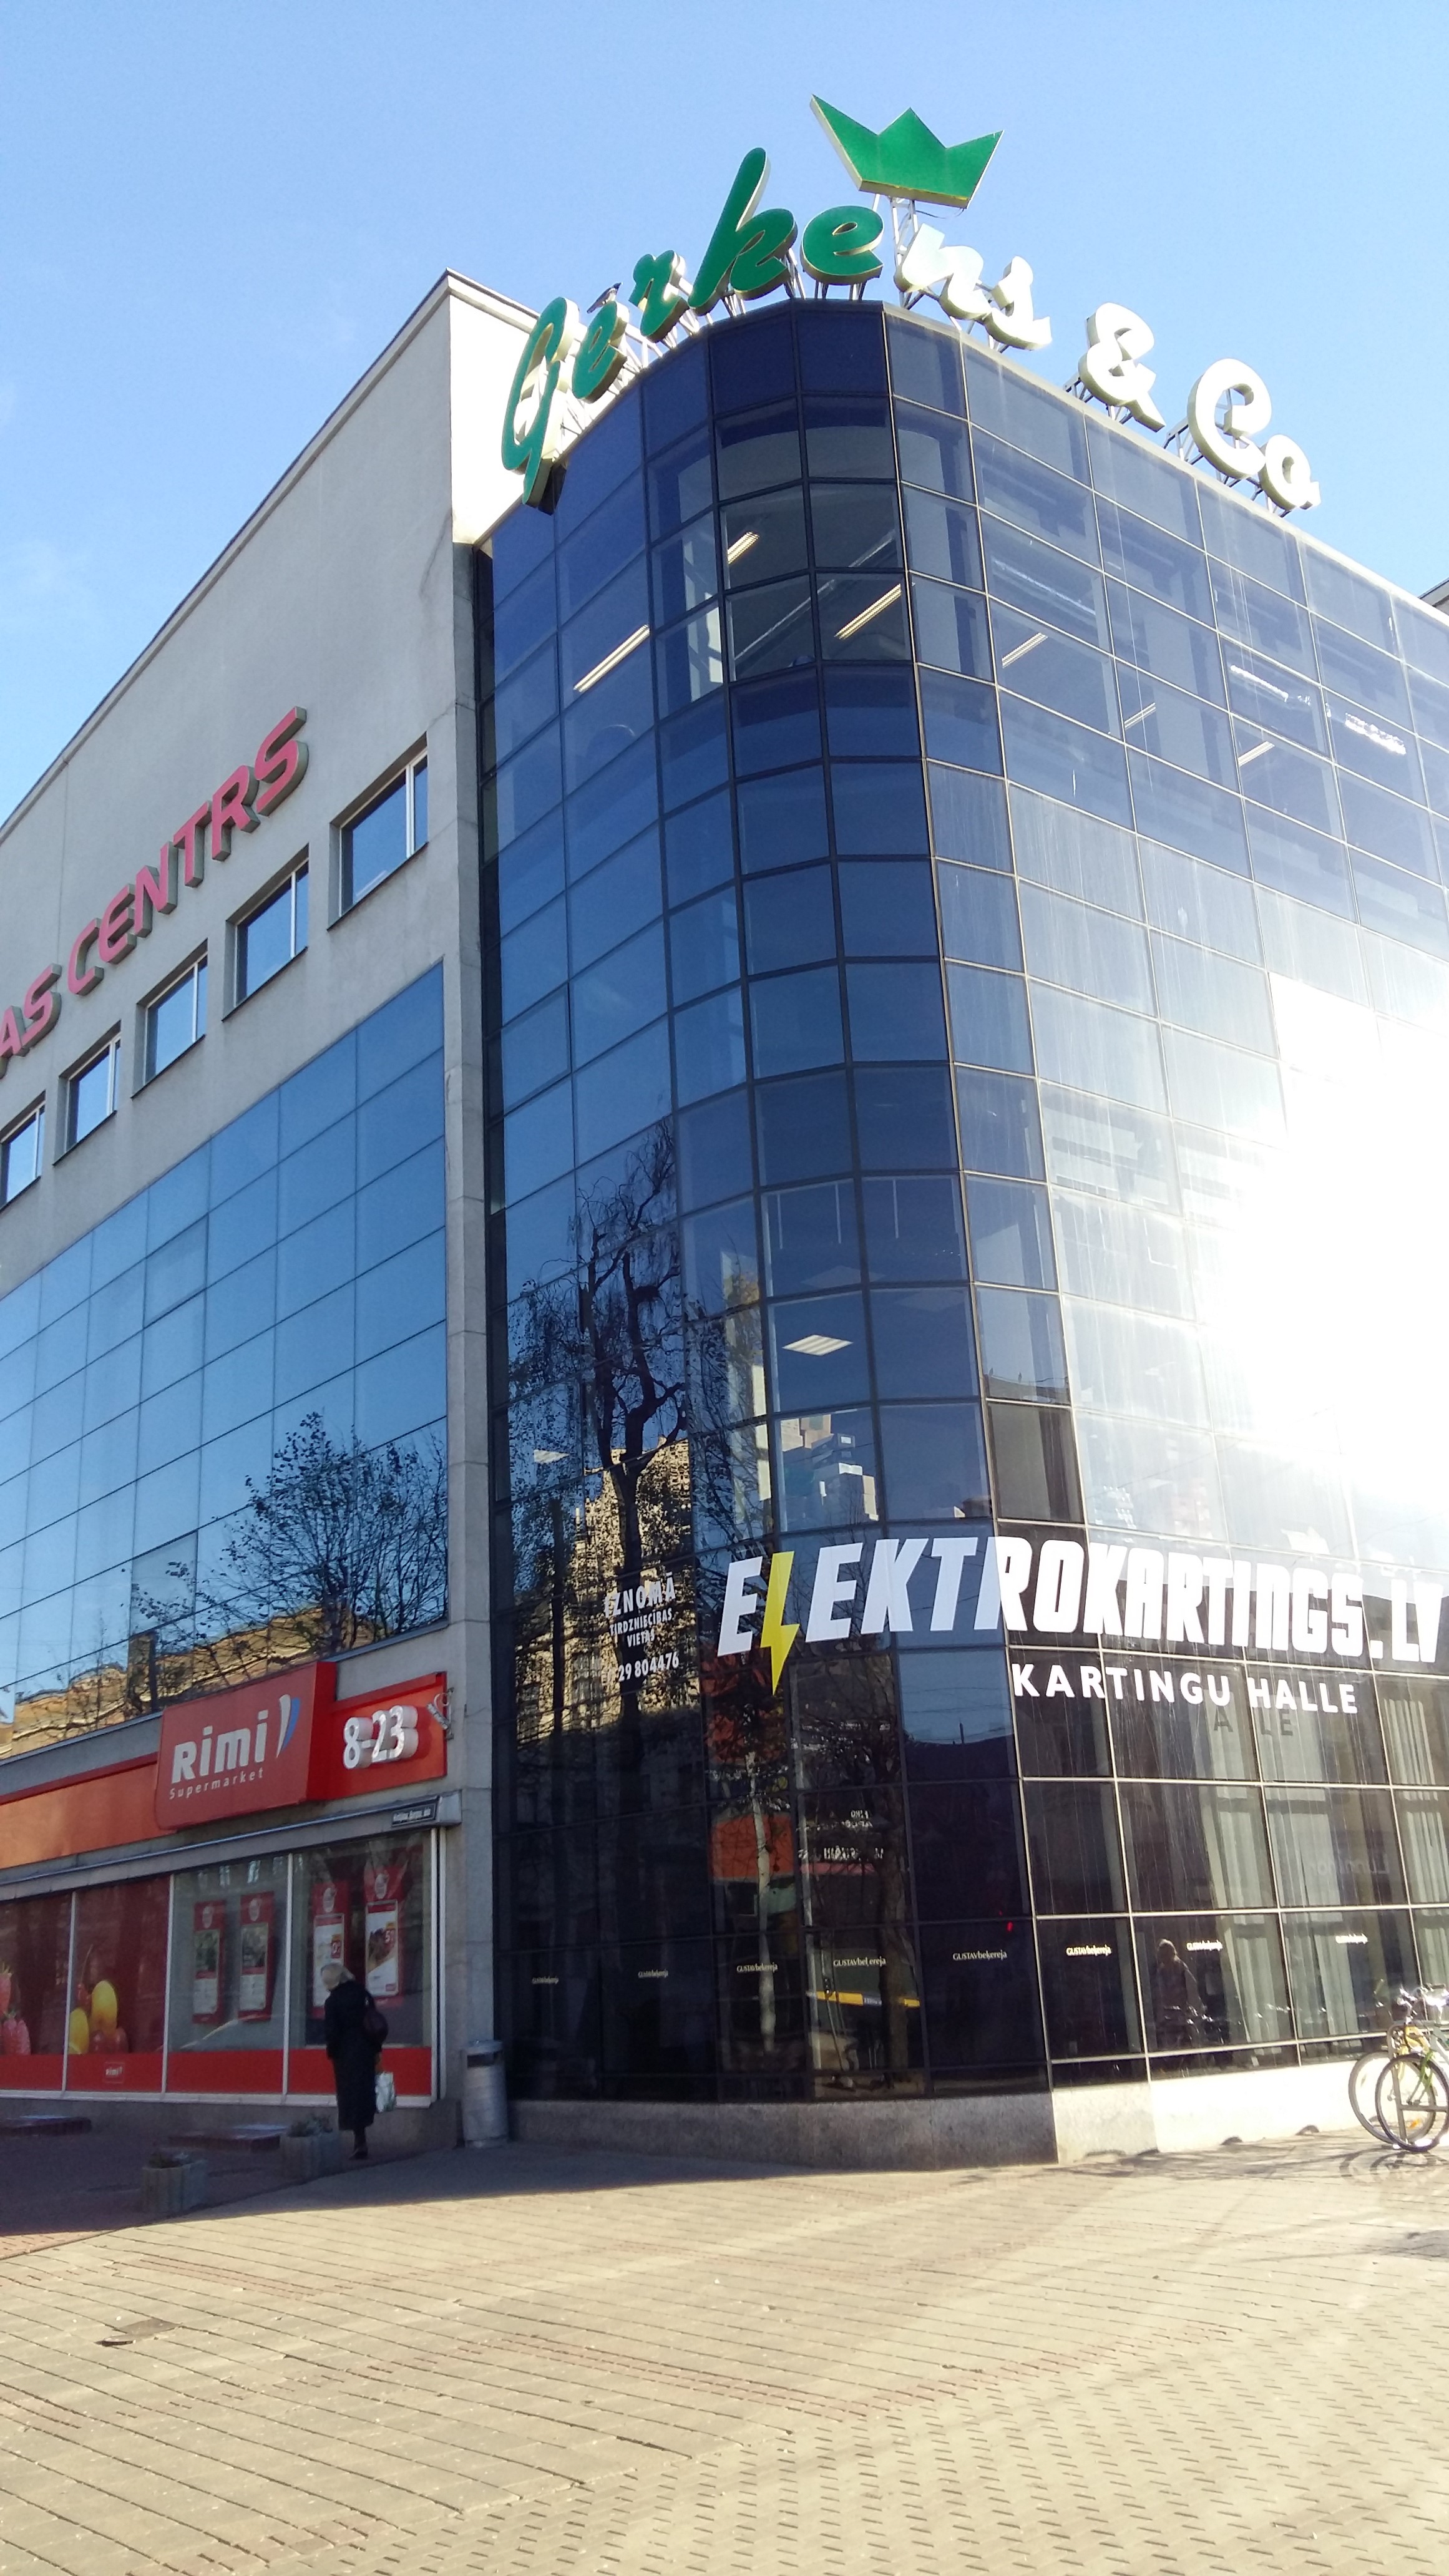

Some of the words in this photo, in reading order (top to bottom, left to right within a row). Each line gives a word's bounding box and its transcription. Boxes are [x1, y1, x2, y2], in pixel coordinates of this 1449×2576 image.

[1078, 301, 1166, 432] &
[67, 706, 310, 997] CENTRS
[609, 1607, 674, 1636] TIRDZNIECĪBAS
[627, 1628, 655, 1647] VIETAS
[717, 1535, 1444, 1695] ELEKTROKARTINGS.LV
[1012, 1662, 1231, 1707] KARTINGU
[1248, 1676, 1359, 1715] HALLE
[171, 1709, 268, 1784] Rimi
[343, 1704, 419, 1770] 8-23
[169, 1767, 264, 1800] Supermarket
